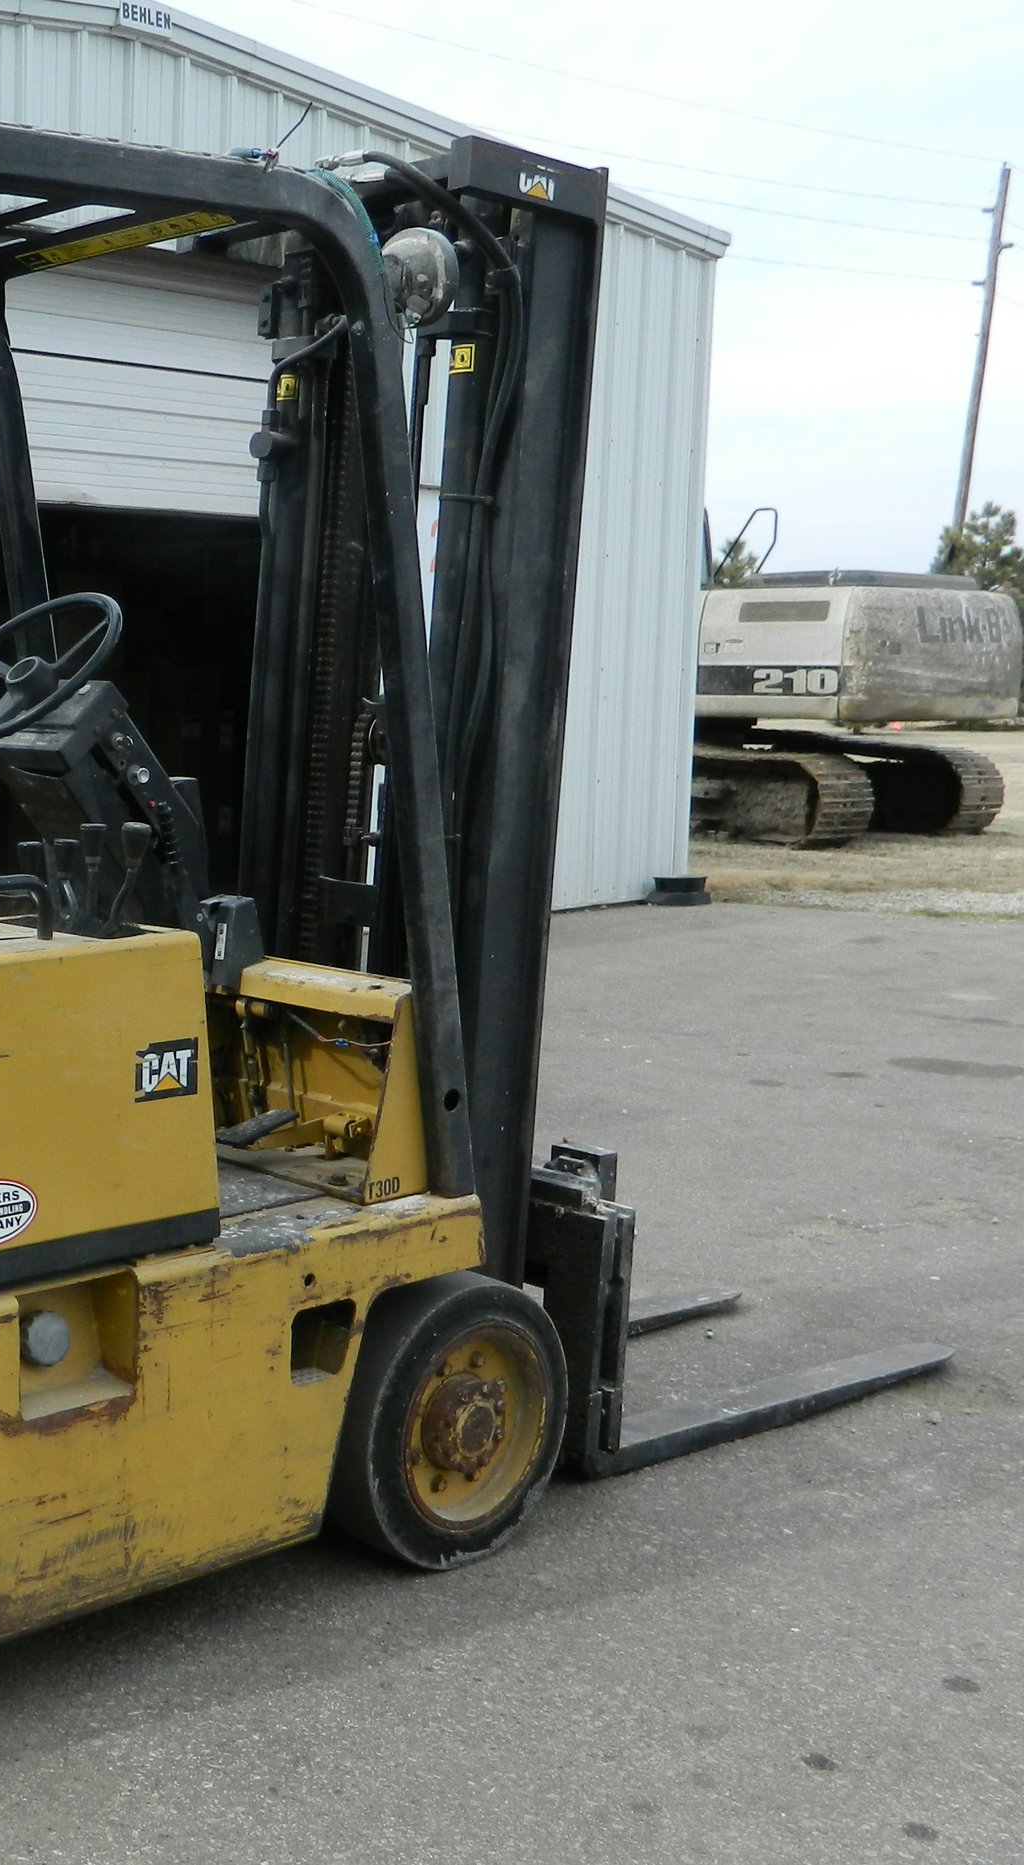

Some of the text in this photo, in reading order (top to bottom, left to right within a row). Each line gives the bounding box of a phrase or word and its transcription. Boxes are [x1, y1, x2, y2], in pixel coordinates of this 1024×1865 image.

[122, 2, 171, 30] BEHLEN
[753, 668, 838, 694] 210
[142, 1049, 192, 1093] CAT
[368, 1176, 400, 1199] T30D
